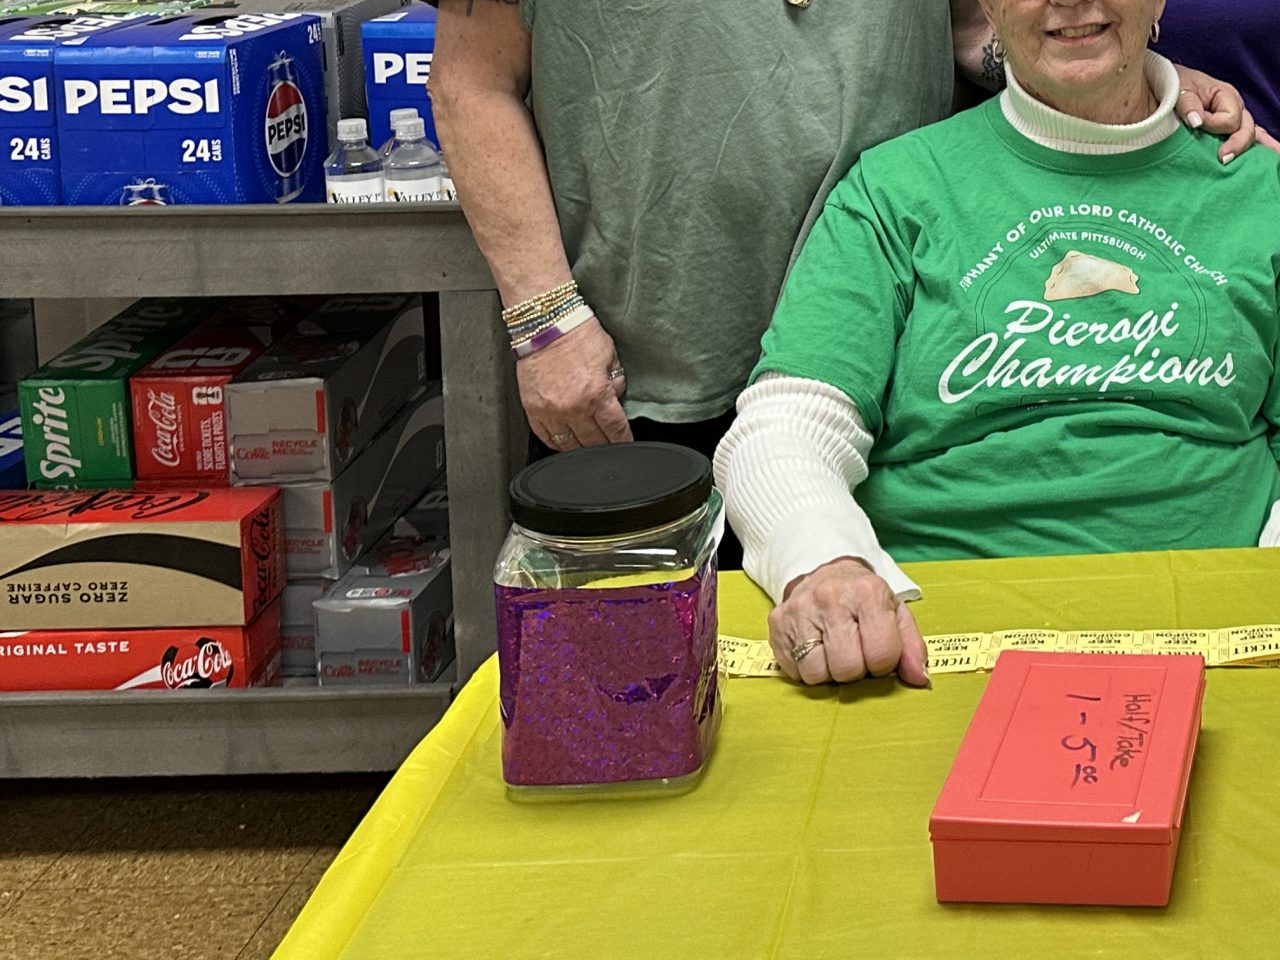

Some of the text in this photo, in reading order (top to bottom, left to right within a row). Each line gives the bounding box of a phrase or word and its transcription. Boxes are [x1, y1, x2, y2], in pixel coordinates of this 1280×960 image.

[64, 78, 220, 115] PEPSI
[267, 113, 305, 145] PEPSI
[10, 137, 51, 161] 24 CANS
[181, 139, 222, 162] 24 CANS
[1006, 222, 1026, 243] OF
[1029, 204, 1065, 224] OUR
[1069, 204, 1114, 218] LORD
[1117, 209, 1186, 256] CATHOLIC
[1029, 231, 1147, 261] ULTIMATE PITTSBURGH
[1003, 300, 1180, 357] Pierogi
[937, 332, 1238, 405] Champions
[32, 386, 82, 479] Sprite
[7, 581, 128, 592] ZERO CAFFEINE
[9, 593, 128, 604] ZERO SUGAR
[0, 641, 130, 656] RIGINAL TASTE
[162, 641, 232, 687] Coca-Cola
[1232, 643, 1280, 655] TICKET
